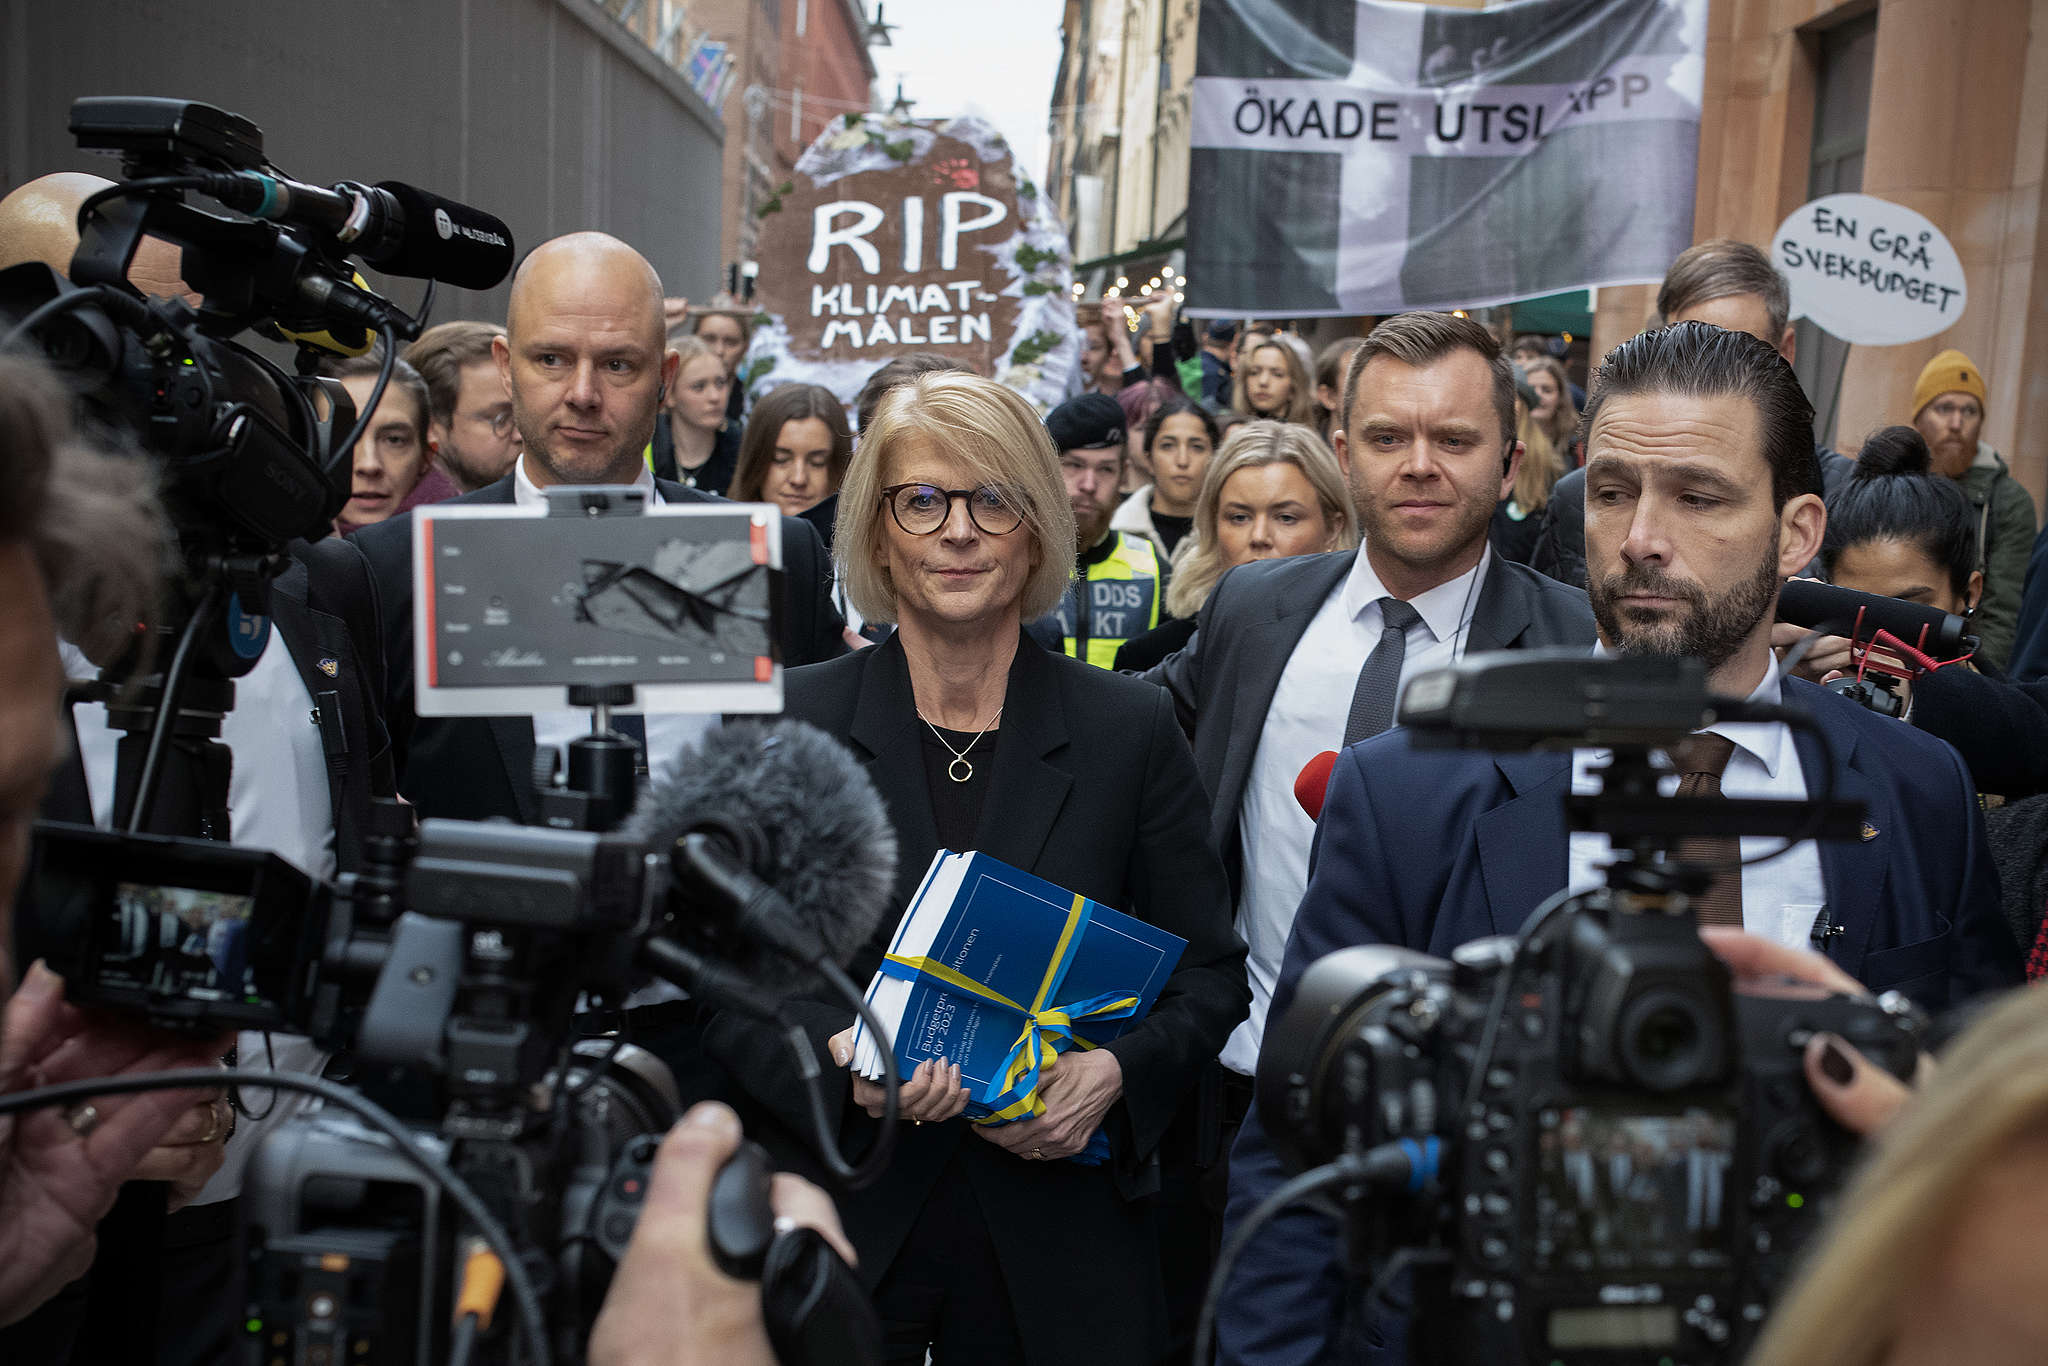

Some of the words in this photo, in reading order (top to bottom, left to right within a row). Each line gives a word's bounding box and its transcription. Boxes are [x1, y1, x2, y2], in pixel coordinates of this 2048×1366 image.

[1234, 87, 1400, 141] ÖKADE
[807, 191, 1008, 275] RIP
[1813, 207, 1857, 239] EN
[1869, 228, 1933, 270] GRÅ
[811, 280, 998, 317] KLIMAT-
[1782, 240, 1962, 313] SVEKBUDGET
[821, 312, 992, 349] MÅLEN
[938, 1004, 956, 1036] 2023
